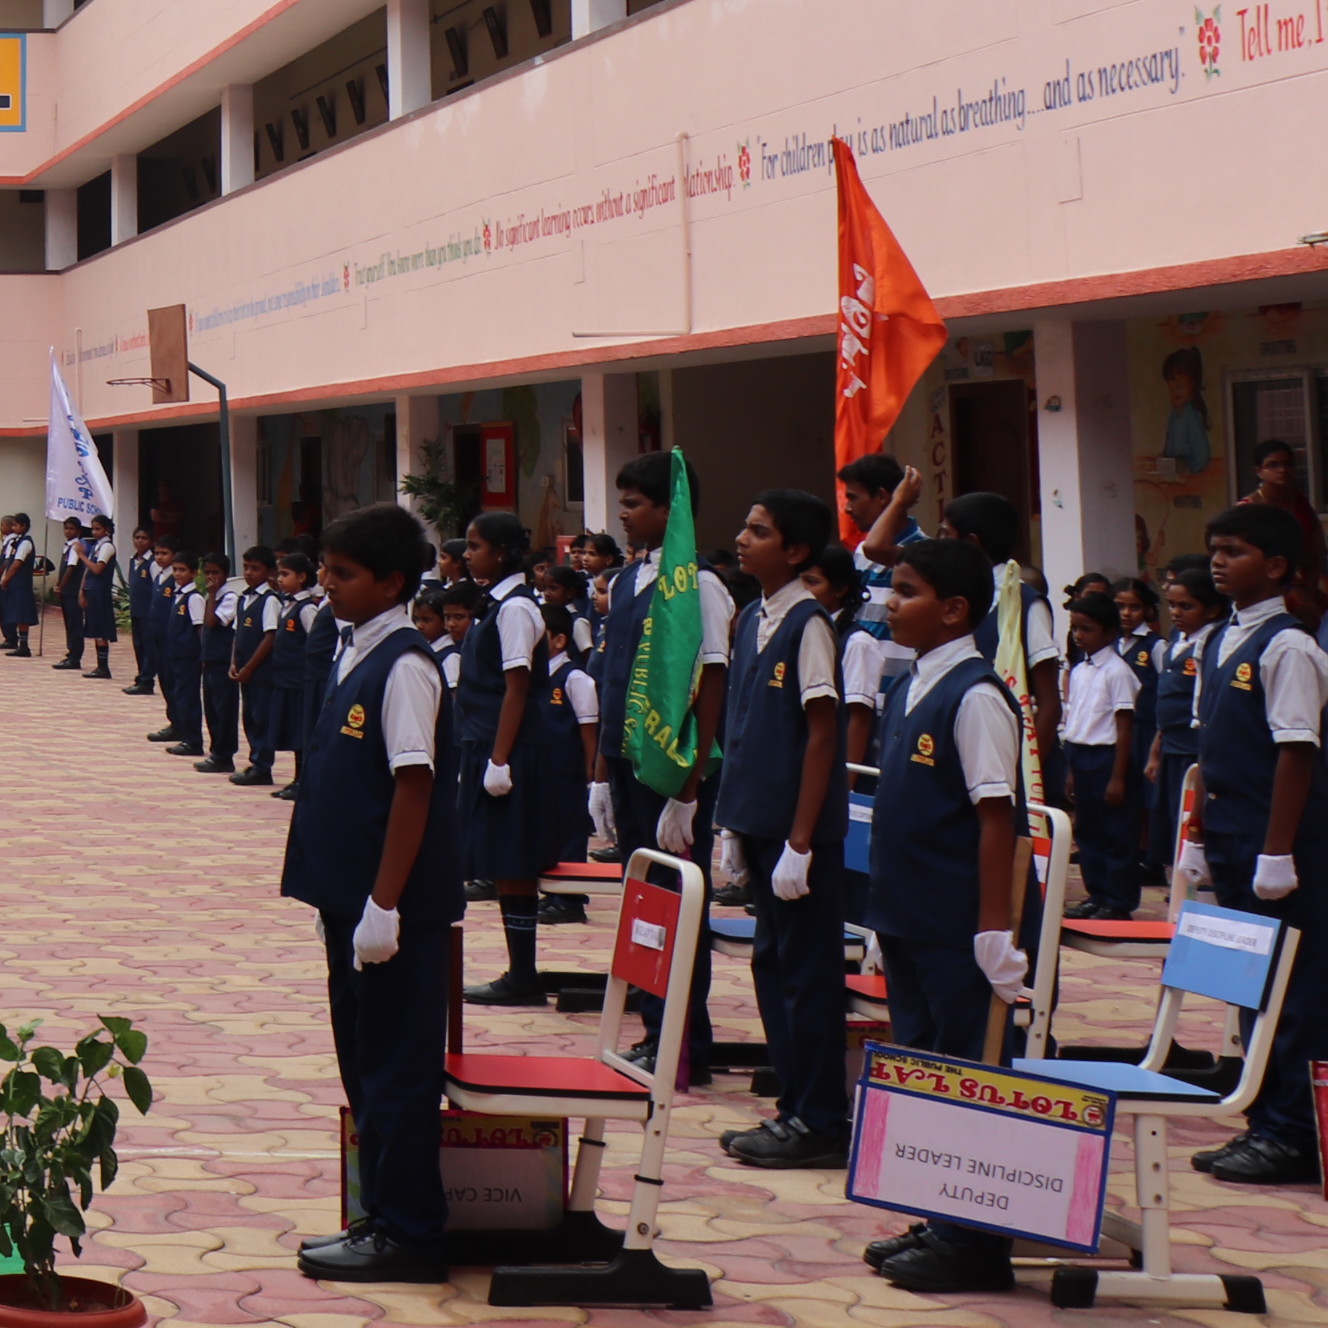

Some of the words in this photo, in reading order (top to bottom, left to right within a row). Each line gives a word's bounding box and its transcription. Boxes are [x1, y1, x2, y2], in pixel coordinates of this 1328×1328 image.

[1236, 3, 1272, 62] Tell
[780, 131, 825, 177] children
[857, 117, 867, 157] is
[871, 125, 885, 154] as
[888, 95, 940, 151] natural
[940, 107, 955, 137] as
[1076, 69, 1094, 103] as
[505, 213, 541, 253] significant
[541, 203, 572, 239] learning
[595, 187, 624, 222] without
[632, 173, 676, 220] significant
[57, 496, 86, 514] PUBLIC
[910, 1057, 943, 1072] PUBLIC
[942, 1063, 963, 1076] THE
[958, 1077, 1079, 1123] LOTUS
[894, 1143, 962, 1171] LEADER
[968, 1158, 1063, 1193] DISCIPLINE
[483, 1187, 523, 1203] VICE
[938, 1181, 1010, 1210] DEPUTY
